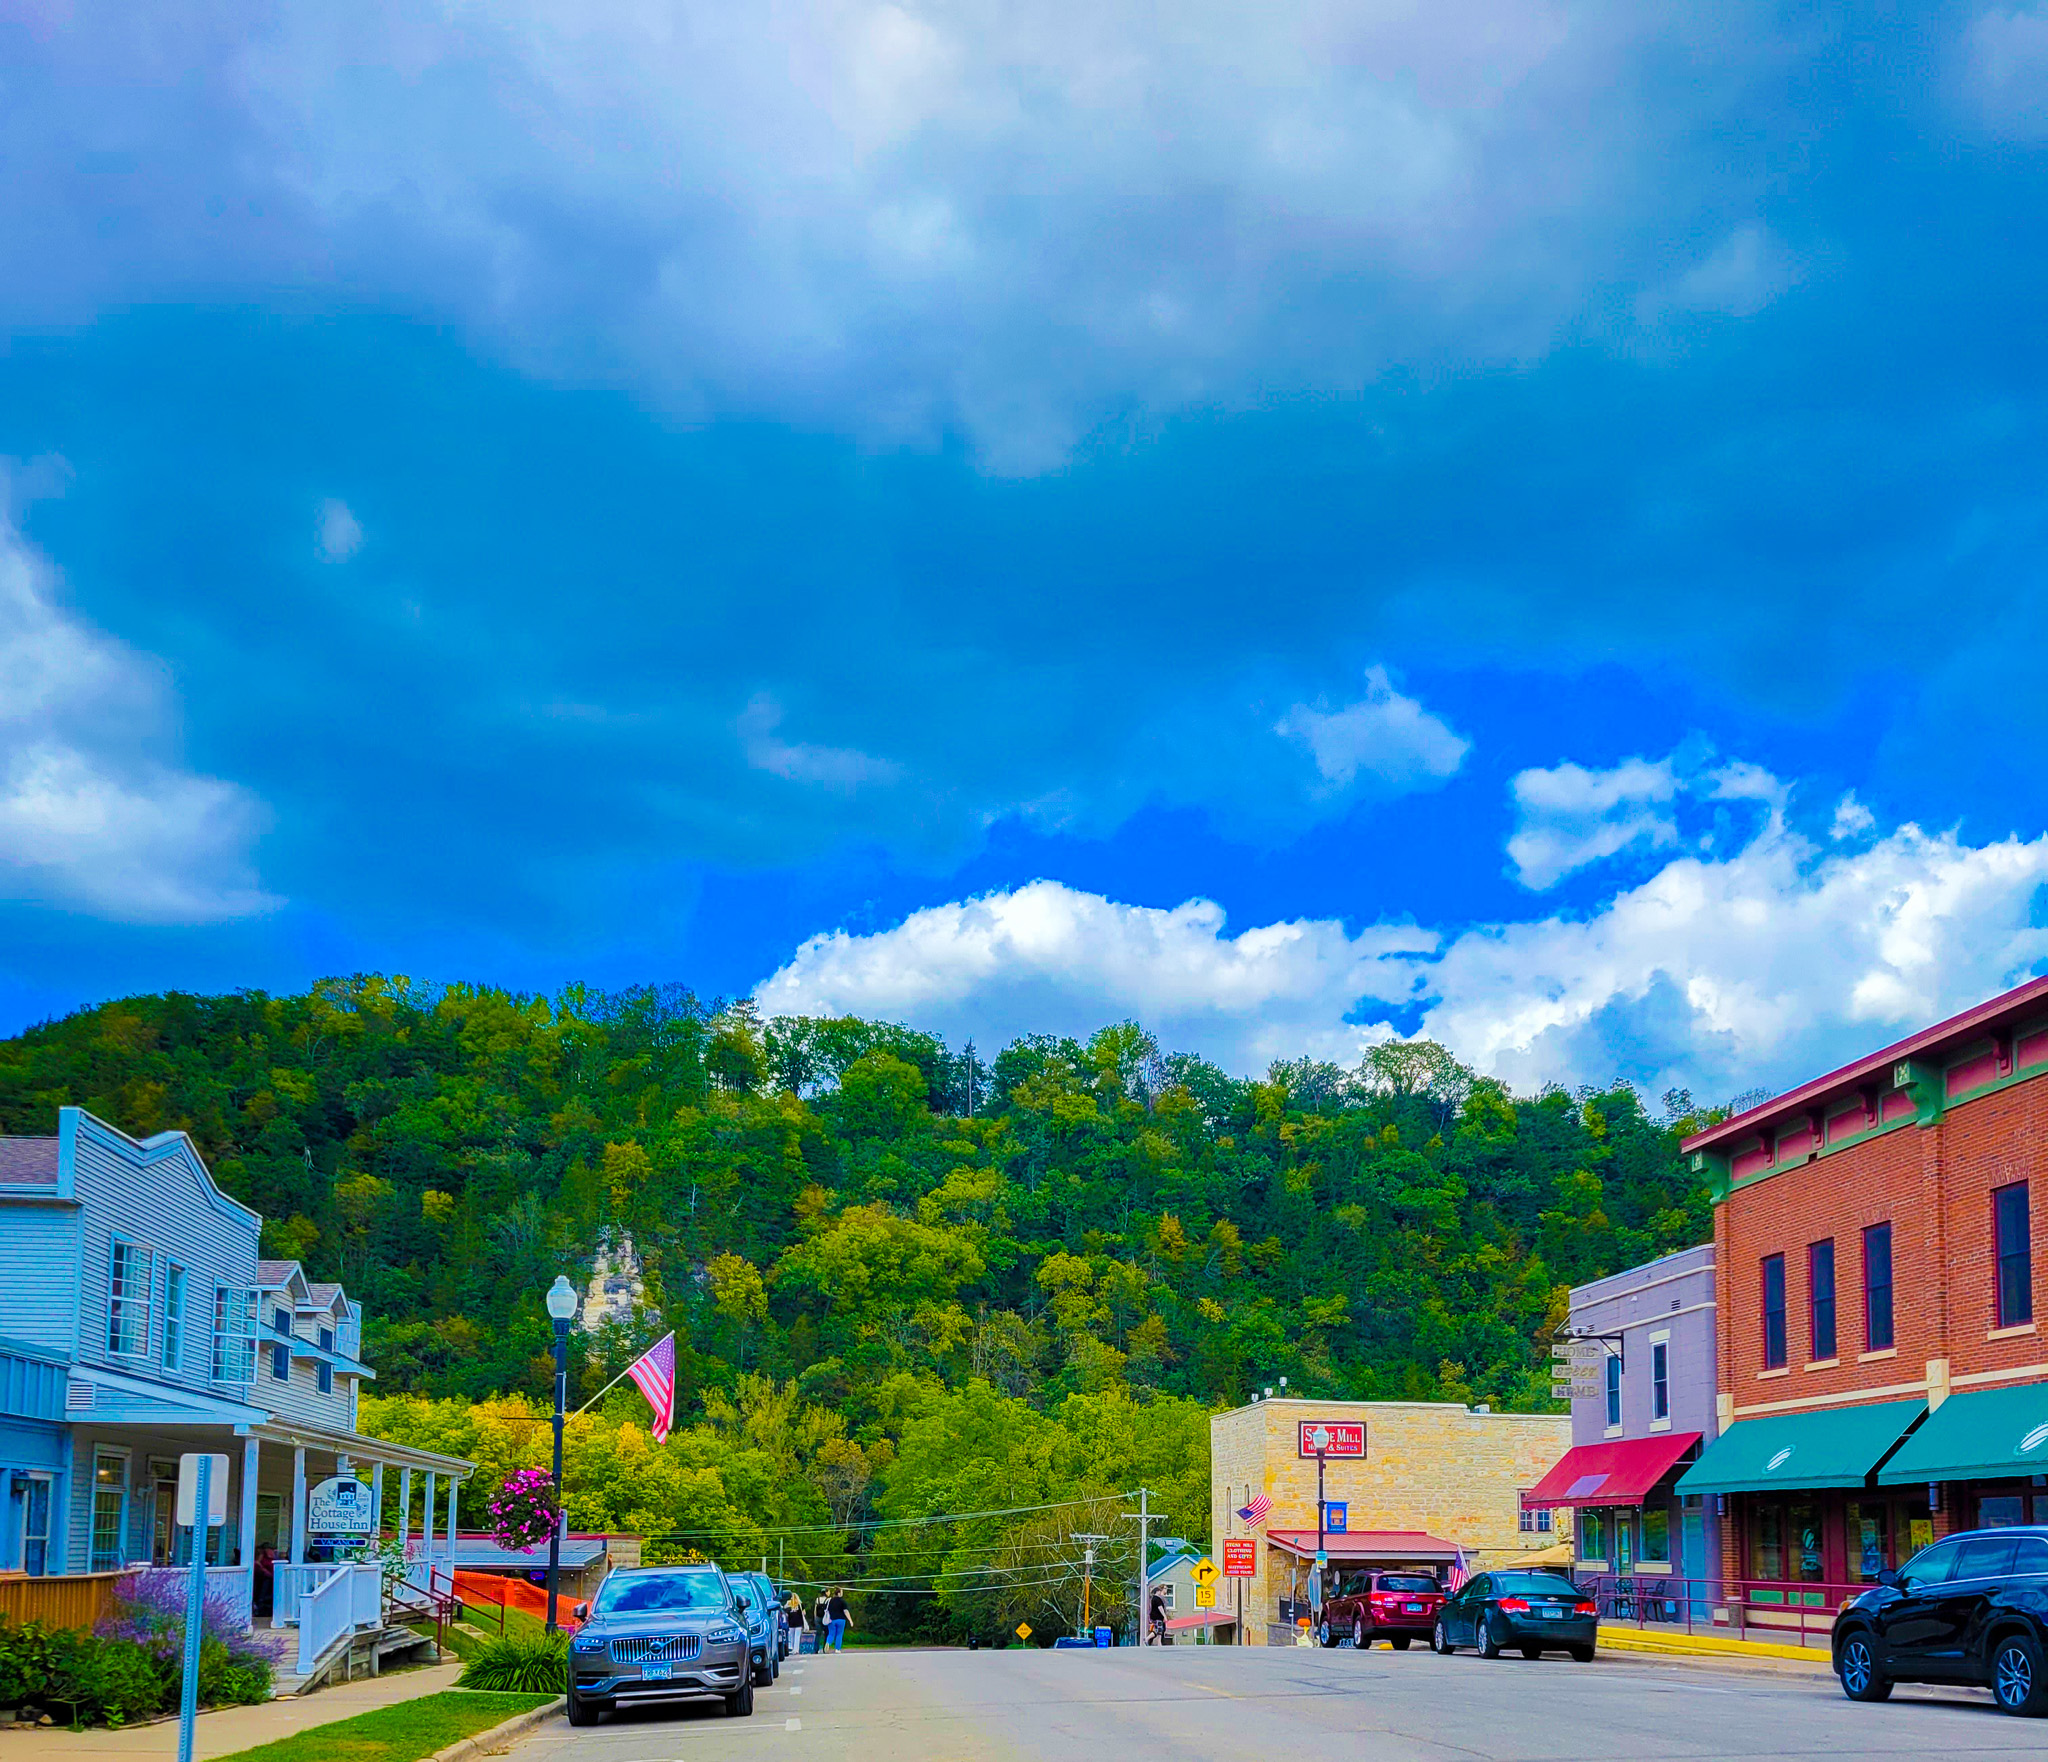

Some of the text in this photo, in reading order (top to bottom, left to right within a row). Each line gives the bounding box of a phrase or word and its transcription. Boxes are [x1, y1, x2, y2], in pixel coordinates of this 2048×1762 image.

[312, 1497, 331, 1506] The
[311, 1507, 355, 1520] Cottage
[310, 1518, 368, 1529] House Inn
[1200, 1590, 1212, 1599] 15
